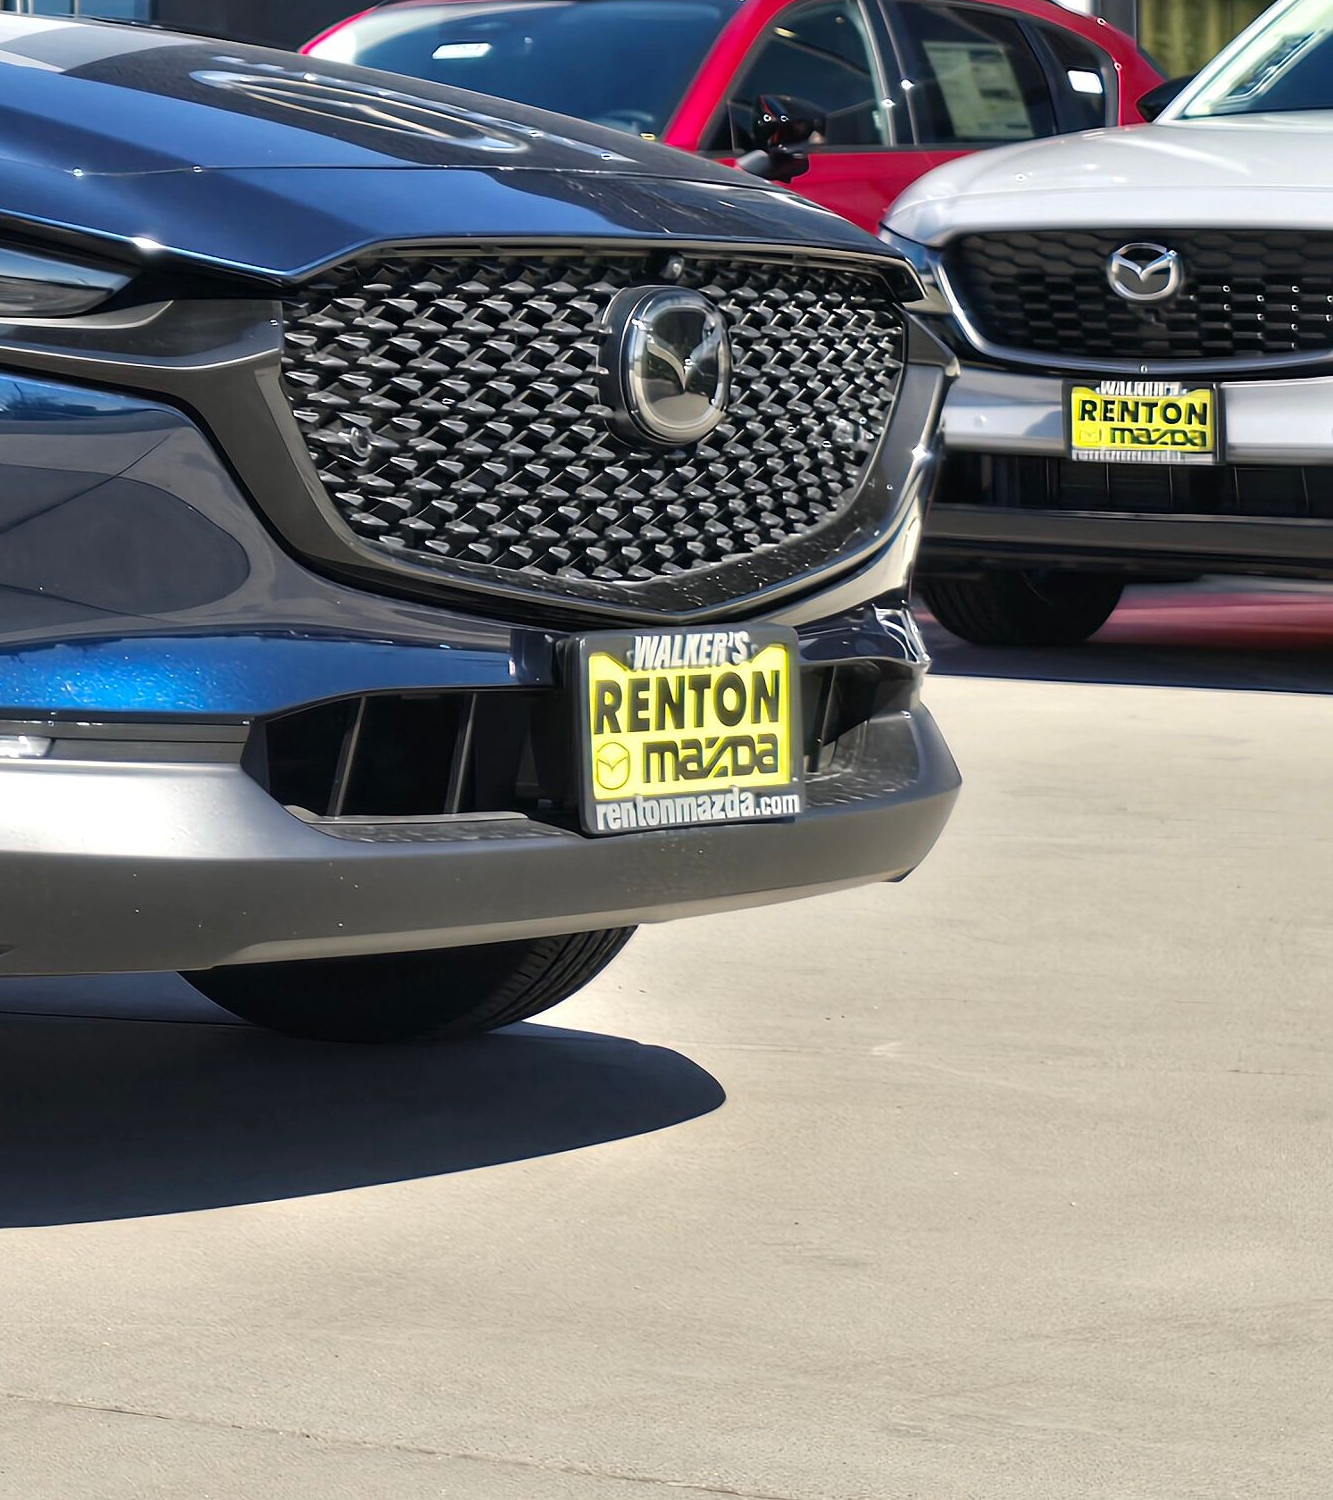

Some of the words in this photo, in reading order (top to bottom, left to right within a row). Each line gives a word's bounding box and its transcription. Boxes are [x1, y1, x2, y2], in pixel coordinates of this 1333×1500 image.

[1079, 399, 1207, 426] RENTON
[633, 630, 749, 669] WALKER'S
[593, 670, 781, 735] RENTON
[642, 733, 779, 784] mazda
[595, 786, 801, 831] rentonmazda.com
